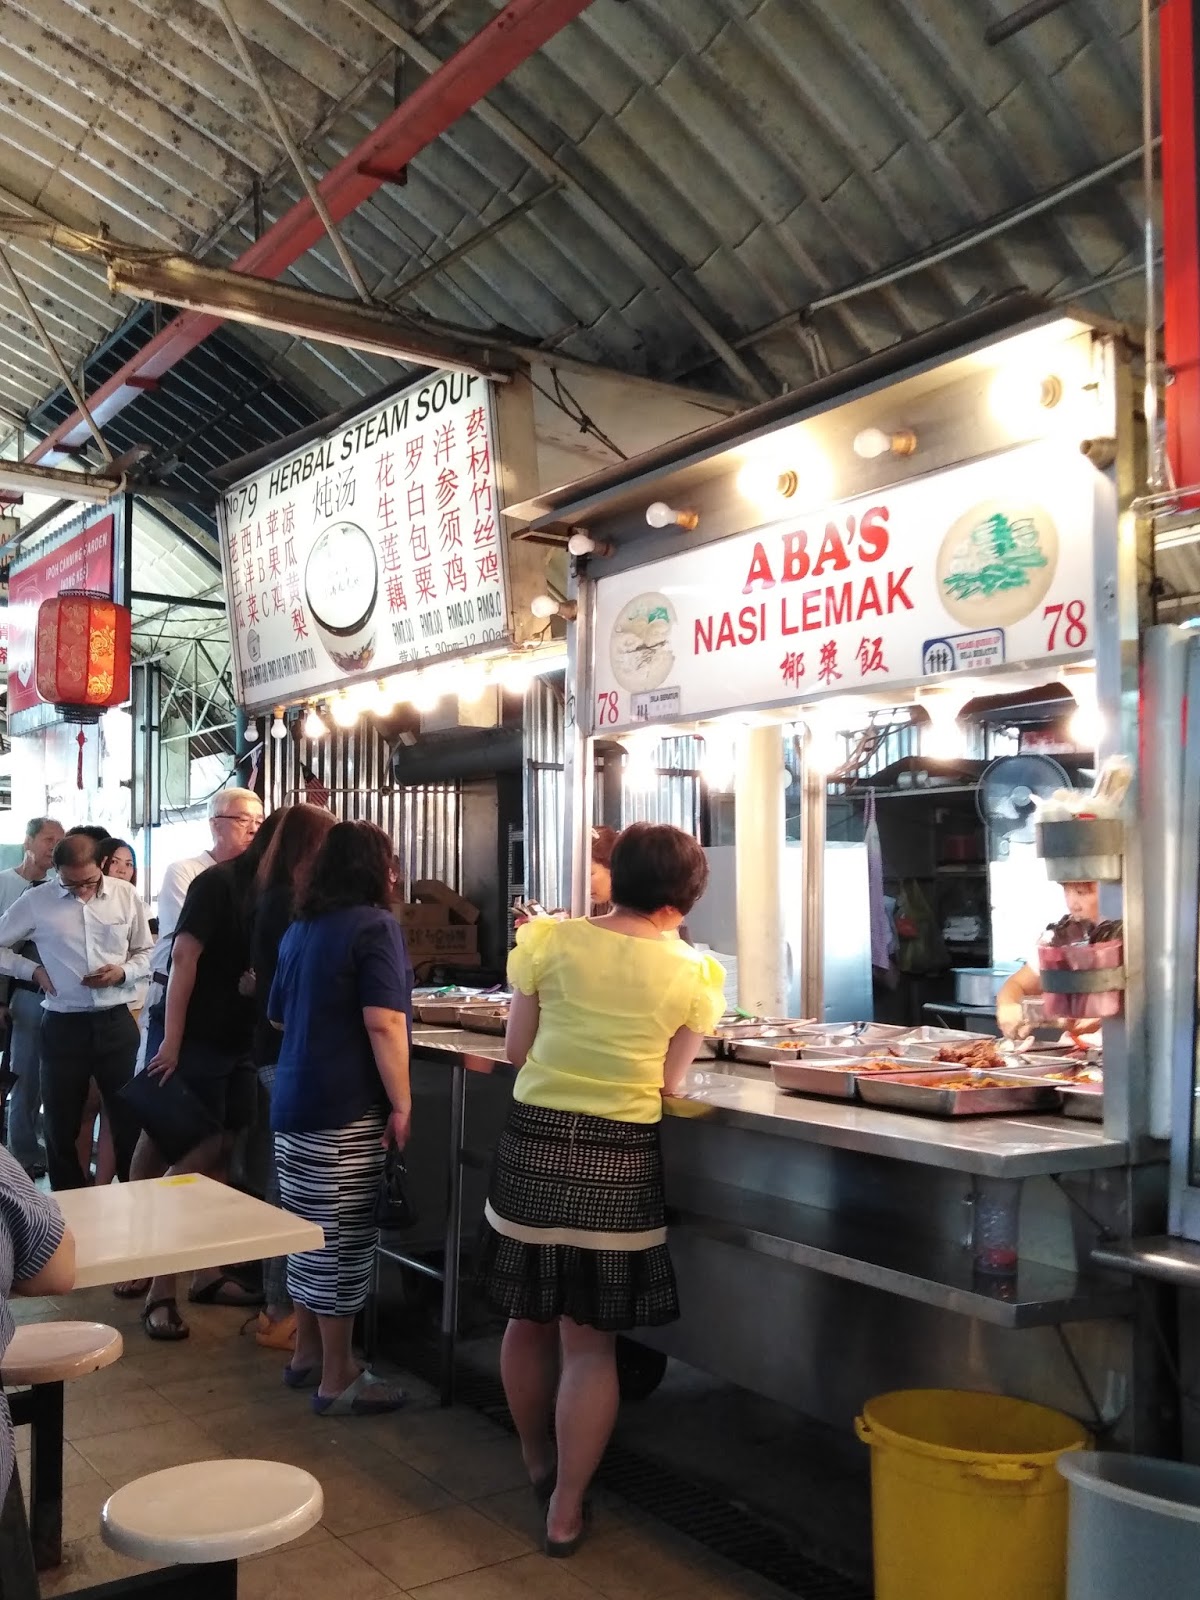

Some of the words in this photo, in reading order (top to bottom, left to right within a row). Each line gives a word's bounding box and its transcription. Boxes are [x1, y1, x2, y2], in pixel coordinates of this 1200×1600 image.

[269, 441, 334, 499] HERBAL
[340, 398, 409, 460] STEAM
[312, 465, 356, 525] 炖汤
[742, 505, 890, 595] ABA'S
[694, 602, 766, 655] NASI
[781, 566, 914, 636] LEMAK
[1042, 600, 1087, 652] 78
[597, 690, 619, 725] 78
